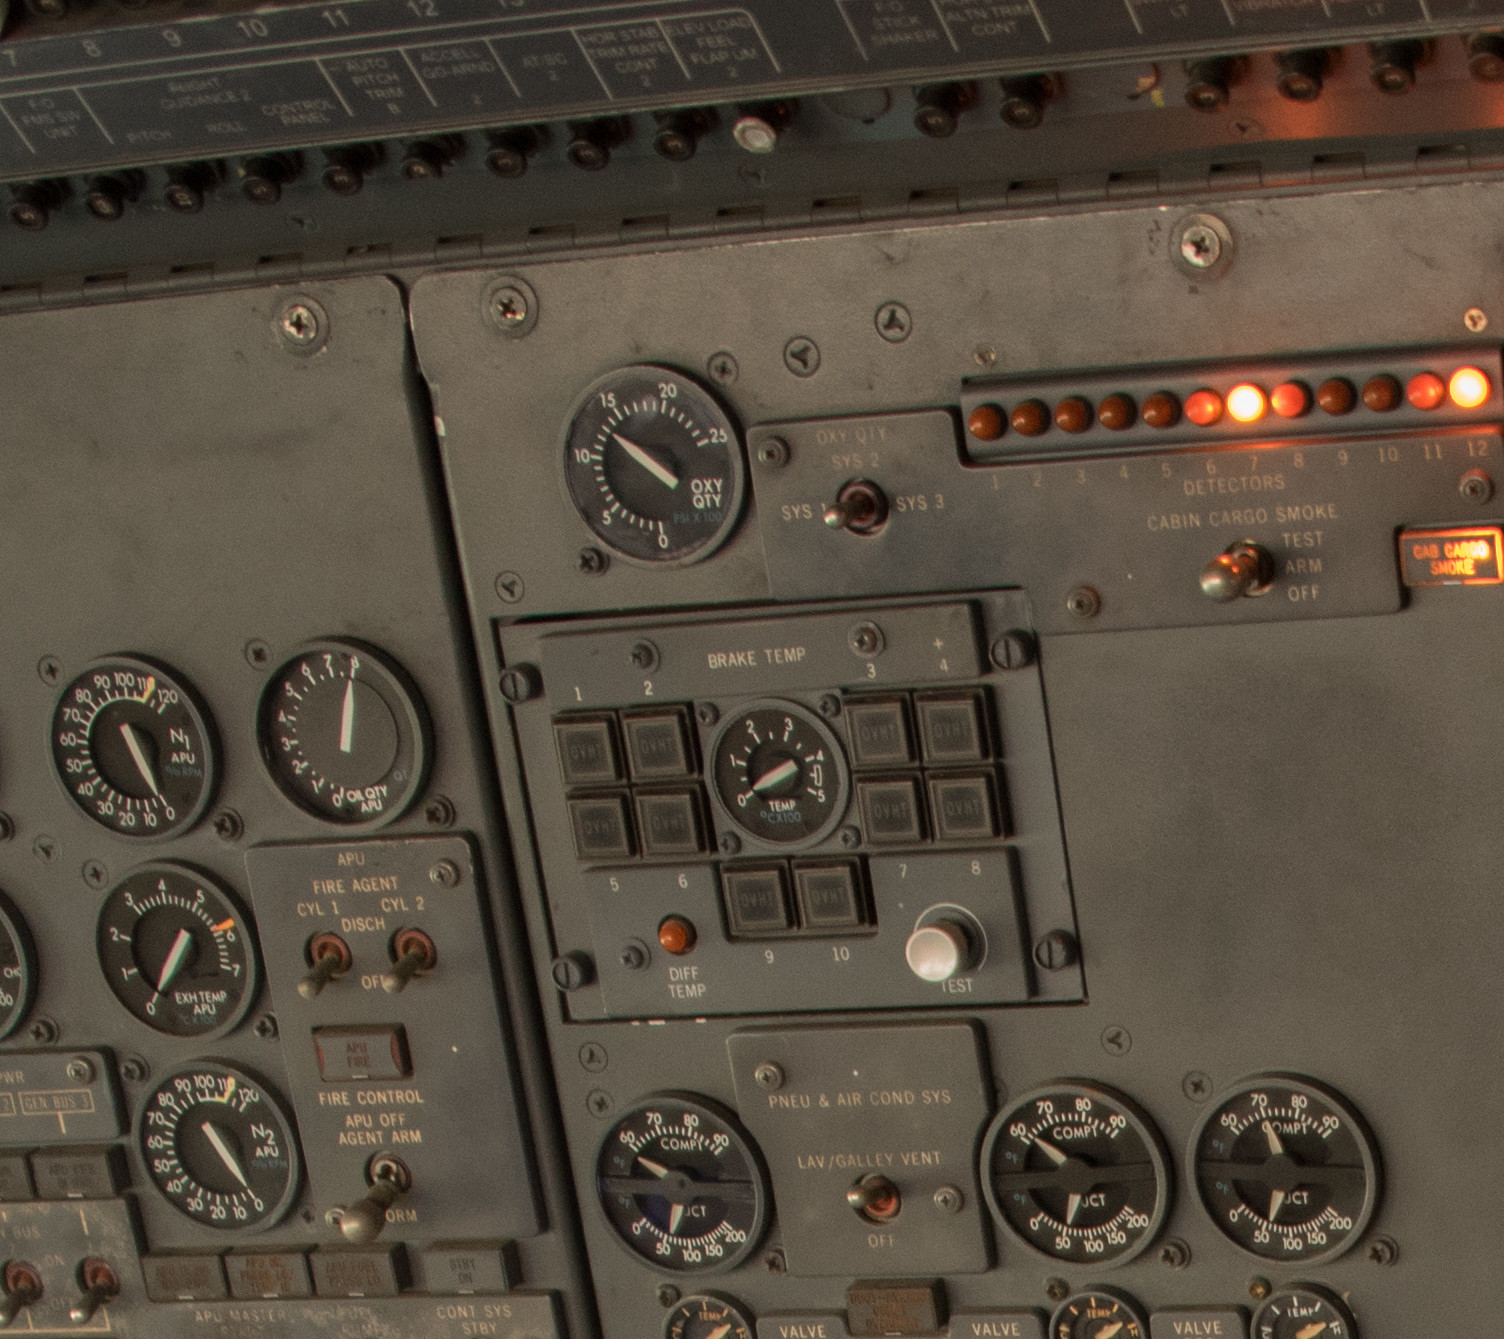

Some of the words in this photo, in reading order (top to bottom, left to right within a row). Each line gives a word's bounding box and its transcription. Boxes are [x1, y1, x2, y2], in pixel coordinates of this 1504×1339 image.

[660, 383, 677, 400] 20
[710, 427, 728, 445] 25
[691, 479, 724, 495] OXY
[1183, 474, 1286, 495] DETECTORS
[692, 493, 723, 509] QTY
[1146, 511, 1202, 532] CABIN
[1208, 507, 1266, 529] CARGO
[1274, 502, 1339, 525] SMOKE
[707, 649, 760, 668] BRAKE
[764, 646, 807, 665] TEMP
[170, 750, 196, 764] APU
[312, 878, 349, 895] FIRE
[353, 875, 399, 892] AGENT
[341, 915, 386, 933] DISCH
[668, 967, 699, 982] DIFF
[667, 982, 707, 998] TEMP
[319, 1090, 353, 1105] FIRE
[357, 1087, 424, 1105] CONTROL
[768, 1093, 808, 1110] PNEU
[818, 1093, 828, 1108] &
[836, 1091, 864, 1107] AIR
[872, 1090, 913, 1107] COND
[919, 1088, 952, 1105] SYS
[339, 1129, 381, 1146] AGENT
[391, 1128, 422, 1144] ARM
[898, 1150, 942, 1166] VENT
[779, 1324, 826, 1339] VALVE
